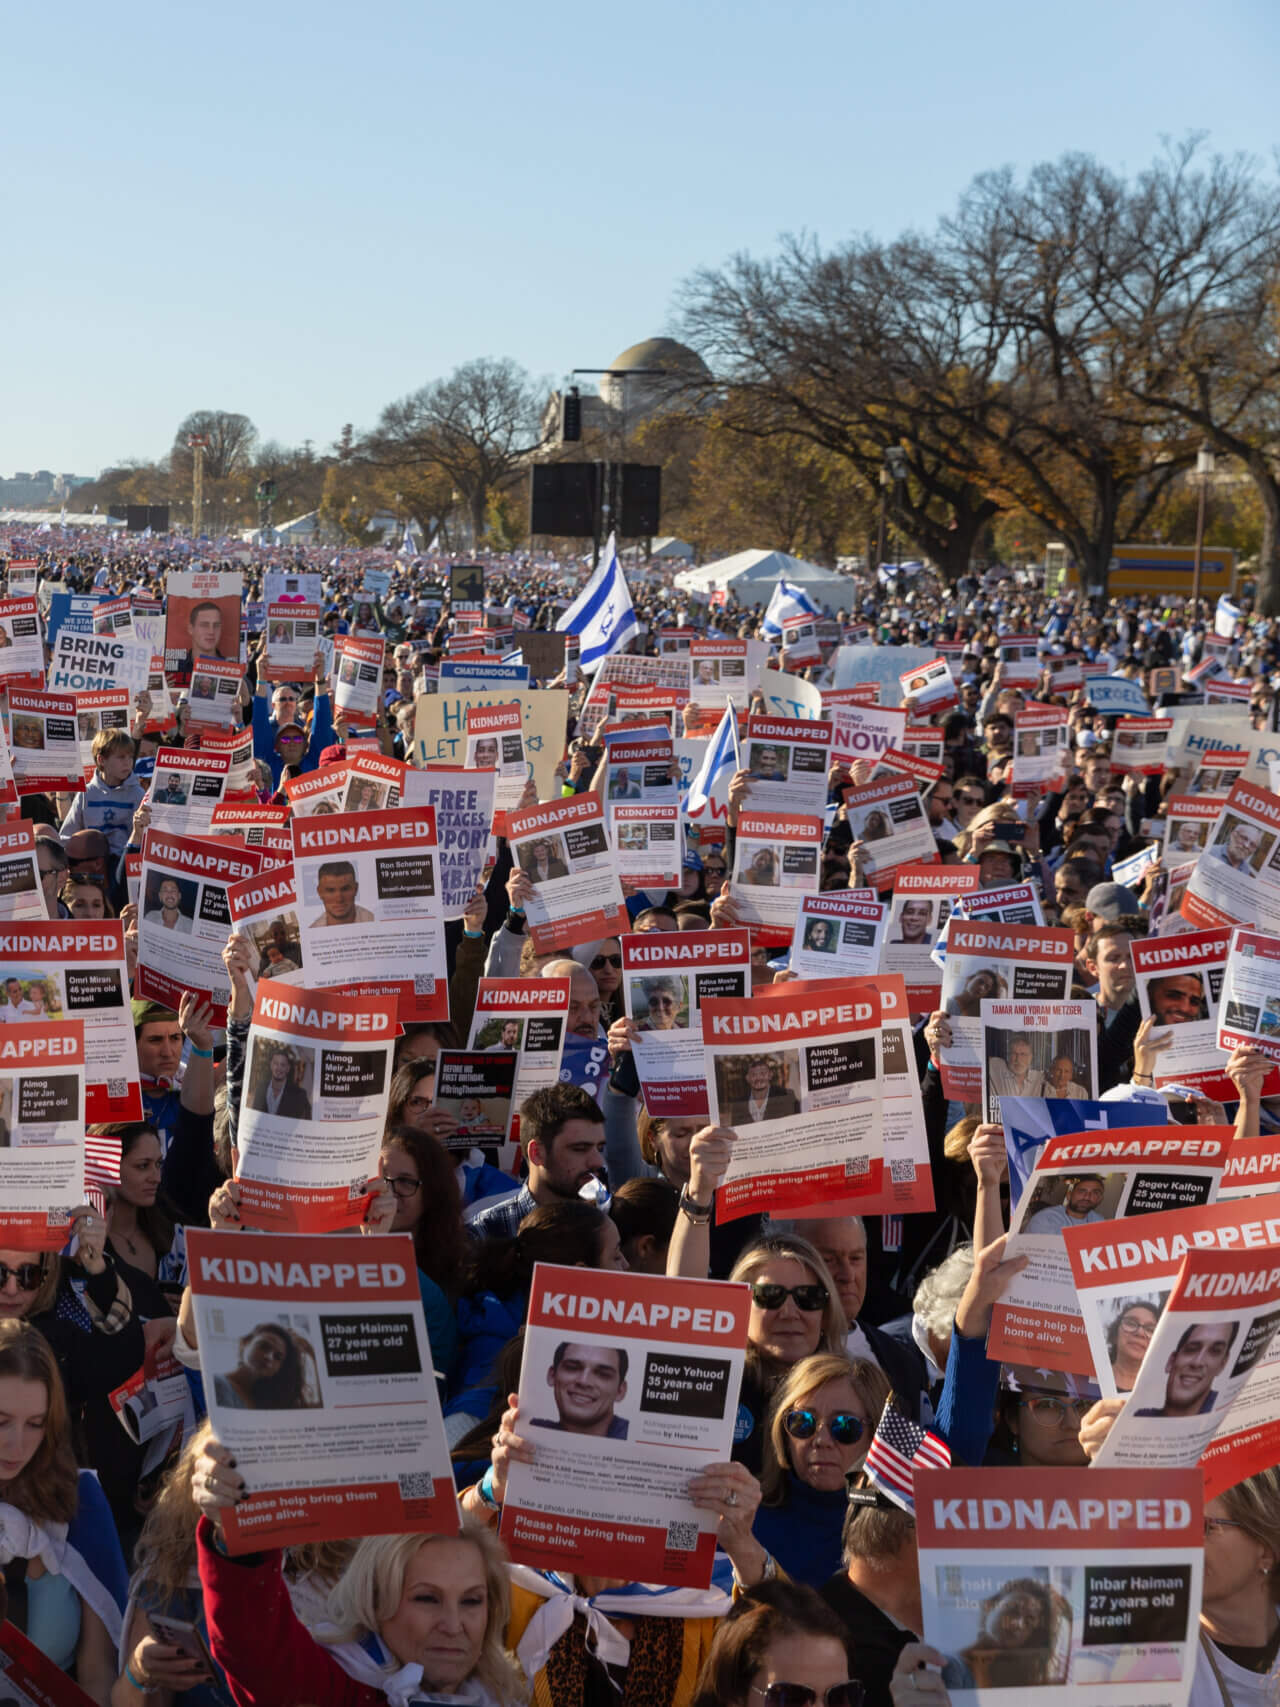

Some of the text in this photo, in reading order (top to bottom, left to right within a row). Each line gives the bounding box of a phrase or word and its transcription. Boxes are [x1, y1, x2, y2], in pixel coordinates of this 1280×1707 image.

[270, 607, 318, 617] KIDNAPPED
[59, 636, 125, 658] BRING
[58, 654, 115, 676] THEM
[195, 662, 242, 676] KIDNAPPED
[453, 666, 517, 677] CHATTANOOGA
[53, 671, 116, 691] HOME
[11, 696, 73, 712] KIDNAPPED
[619, 696, 673, 706] KIDNAPPED
[470, 712, 519, 729] KIDNAPPED
[752, 723, 829, 740] KIDNAPPED
[835, 728, 897, 752] NOW
[420, 738, 460, 761] LET
[611, 748, 670, 760] KIDNAPPED
[159, 754, 227, 769] KIDNAPPED
[884, 752, 939, 776] KIDNAPPED
[429, 789, 478, 810] FREE
[848, 779, 914, 804] KIDNAPPED
[216, 810, 285, 820] KIDNAPPED
[511, 802, 597, 833] KIDNAPPED
[617, 807, 674, 817] KIDNAPPED
[300, 821, 430, 848] KIDNAPPED
[742, 821, 817, 836] KIDNAPPED
[150, 842, 253, 878] KIDNAPPED
[898, 876, 974, 888] KIDNAPPED
[807, 900, 879, 916] KIDNAPPED
[628, 942, 744, 961] KIDNAPPED
[953, 933, 1068, 954] KIDNAPPED
[482, 989, 565, 1004] KIDNAPPED
[259, 997, 388, 1032] KIDNAPPED
[712, 1002, 873, 1035] KIDNAPPED
[1053, 1005, 1082, 1016] METZGER
[325, 1053, 353, 1064] Almog
[325, 1063, 361, 1073] Meir Jan
[324, 1072, 374, 1085] 21 years old
[324, 1083, 350, 1093] Israeli
[1050, 1140, 1221, 1161] KIDNAPPED
[1138, 1180, 1204, 1193] Segev Kalfon
[1135, 1189, 1195, 1202] 25 years old
[1132, 1198, 1163, 1210] Israeli
[200, 1256, 406, 1288] KIDNAPPED
[541, 1291, 735, 1334] KIDNAPPED
[325, 1322, 408, 1335] Inbar Haiman
[327, 1335, 403, 1350] 27 years old
[329, 1351, 368, 1362] Israeli
[649, 1362, 724, 1380] Dolev Yehuod
[648, 1376, 713, 1392] 35 years old
[645, 1389, 680, 1401] Israeli
[932, 1498, 1192, 1531] KIDNAPPED
[515, 1515, 645, 1544] Please help bring them
[513, 1528, 578, 1549] home alive.
[1090, 1576, 1183, 1591] Inbar Haiman
[1089, 1593, 1175, 1612] 27 years old
[1088, 1612, 1131, 1627] Israeli
